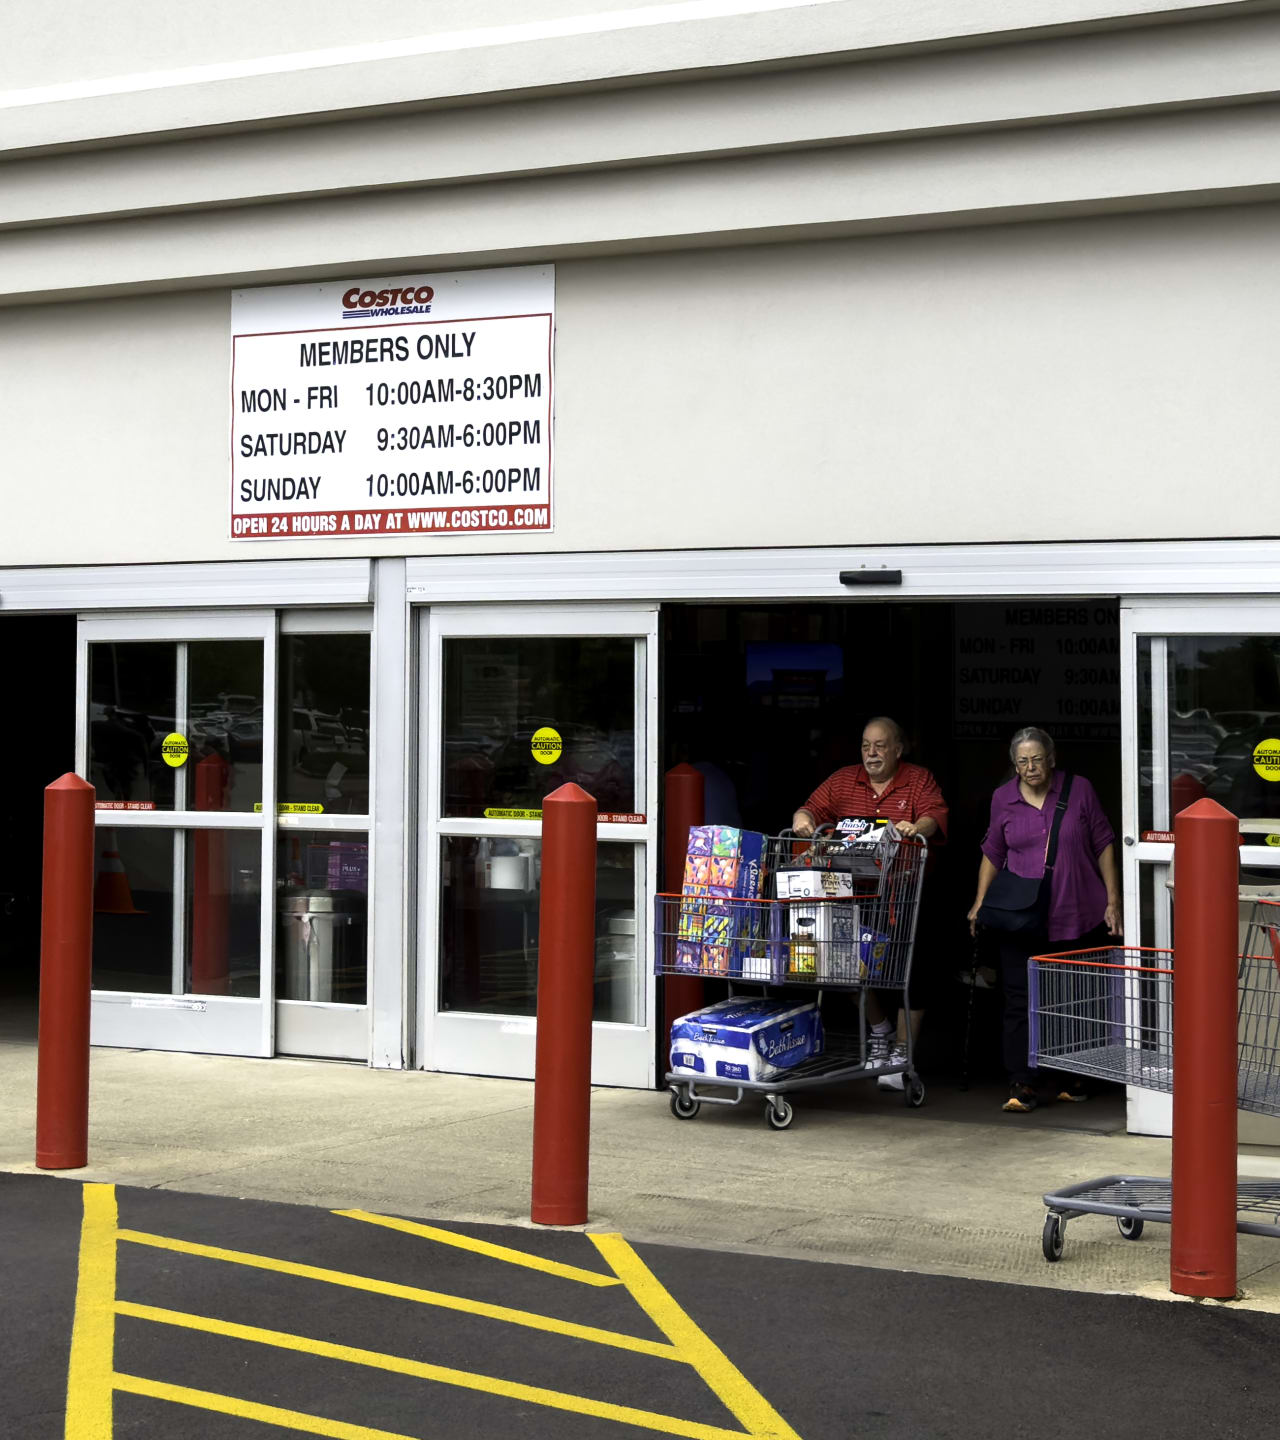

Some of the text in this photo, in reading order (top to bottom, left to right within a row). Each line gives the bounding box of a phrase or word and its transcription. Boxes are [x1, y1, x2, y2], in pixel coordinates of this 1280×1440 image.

[342, 285, 434, 308] COSTCO
[370, 305, 431, 317] WHOLESALE
[300, 332, 476, 367] MEMBERS ONLY
[241, 389, 287, 413] MON
[307, 386, 338, 410] FRI
[366, 373, 541, 406] 10:00AM-8:30PM
[240, 420, 540, 457] SATURDAY 9:30AM-6:00PM
[240, 467, 540, 502] SUNDAY 10:00AM-6:00PM
[233, 508, 548, 534] OPEN 24 HOURS A DAY AT WWW.COSTCO.COM
[1006, 608, 1088, 626] MEMBERS
[959, 638, 995, 654] MON
[1010, 638, 1035, 653] FRI
[959, 668, 1041, 684] SATURDAY
[959, 697, 1022, 714] SUNDAY
[531, 742, 562, 750] CAUTION
[628, 815, 643, 823] CLEAR
[841, 818, 866, 829] finish
[1146, 832, 1175, 841] AUTOMATI
[769, 1032, 806, 1059] Bath Tissue
